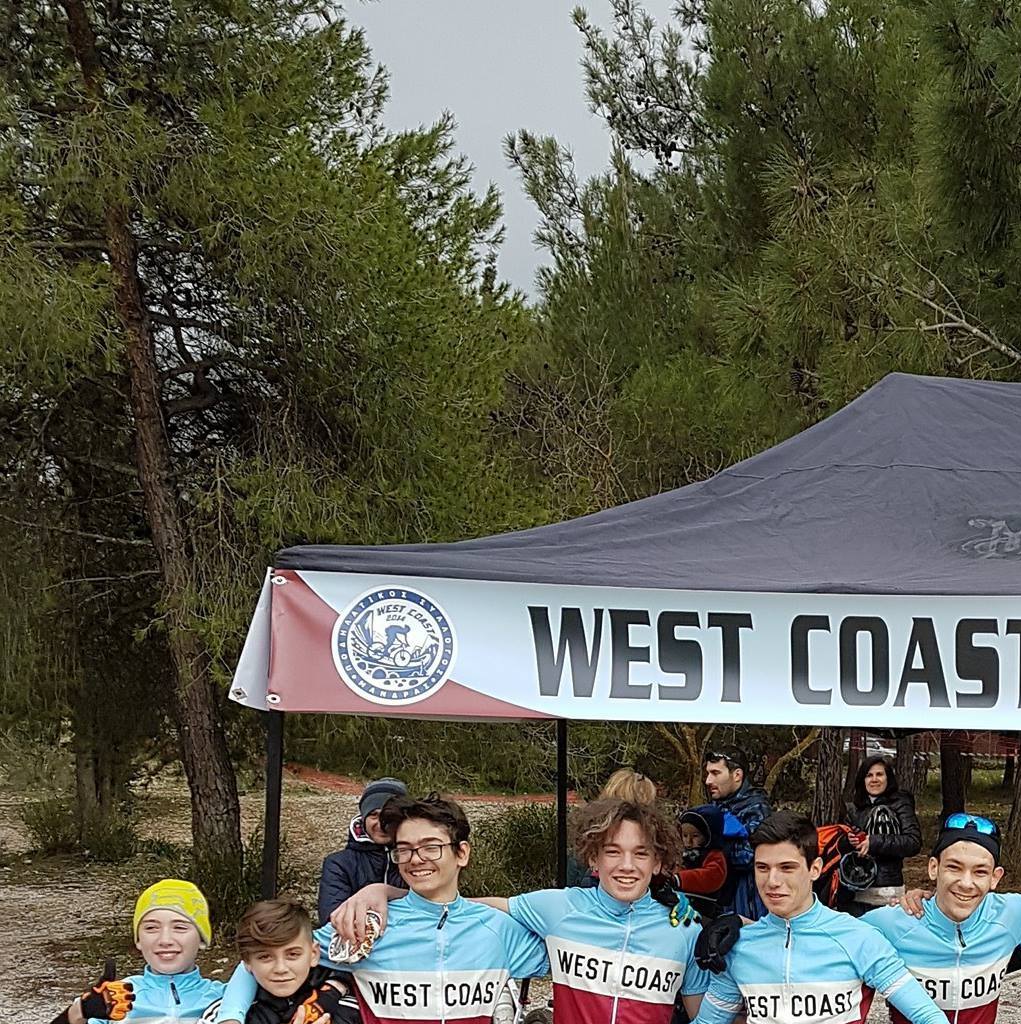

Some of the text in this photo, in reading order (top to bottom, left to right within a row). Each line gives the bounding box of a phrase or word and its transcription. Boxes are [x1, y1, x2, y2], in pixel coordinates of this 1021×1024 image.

[377, 604, 436, 635] WEST COAST
[527, 605, 754, 703] WEST
[557, 949, 681, 993] WEST COAST
[368, 981, 500, 1007] WEST COAS
[791, 990, 853, 1017] COAST
